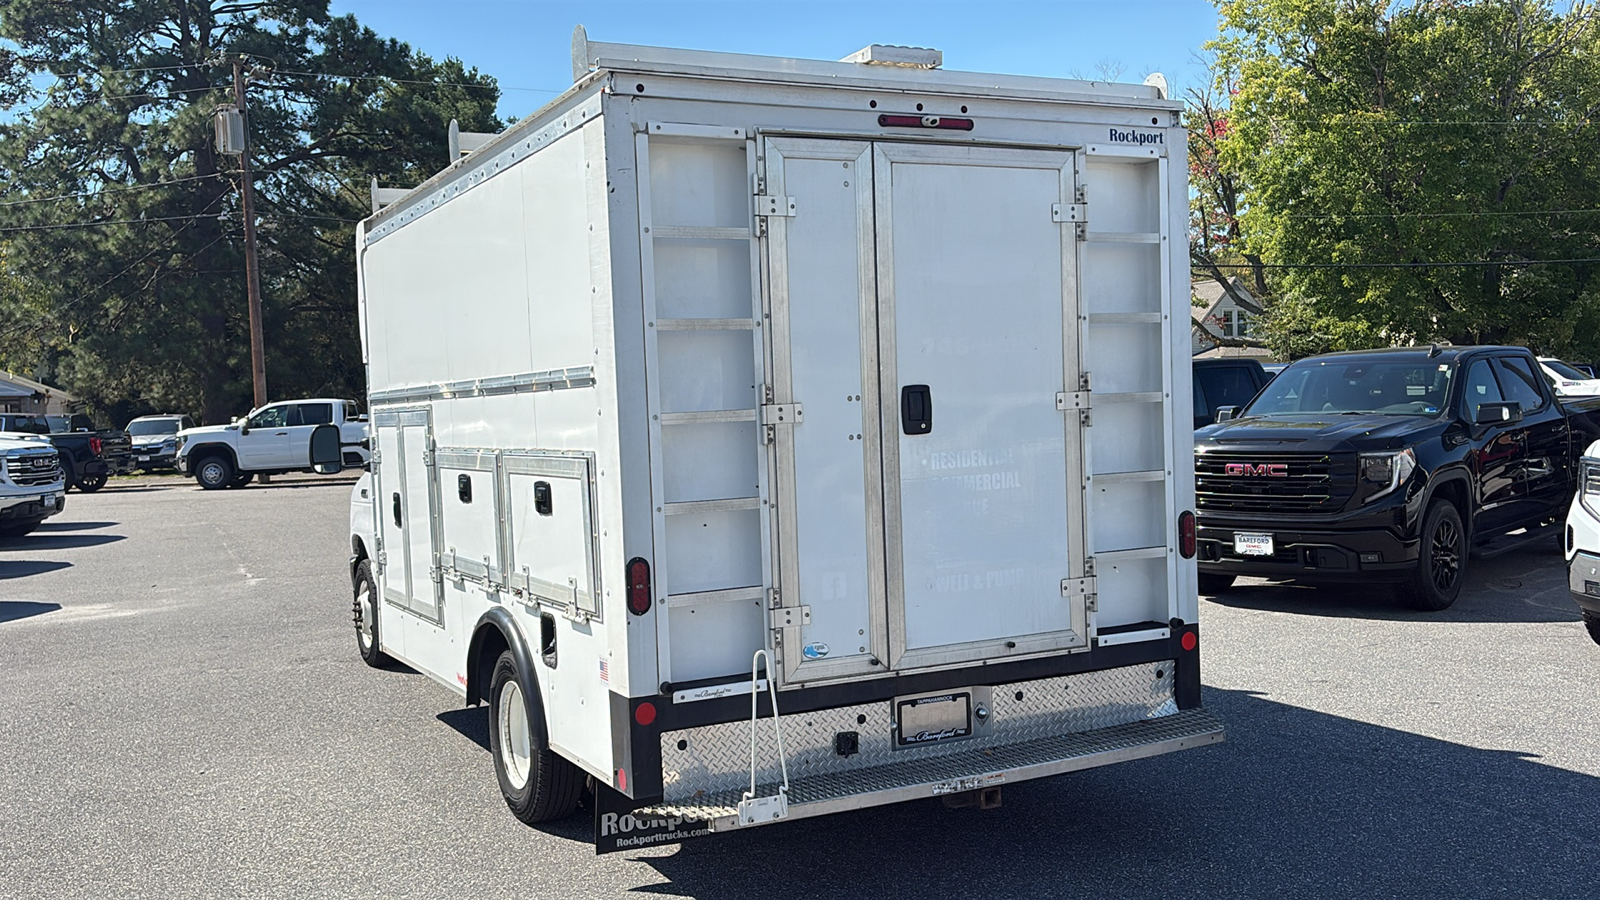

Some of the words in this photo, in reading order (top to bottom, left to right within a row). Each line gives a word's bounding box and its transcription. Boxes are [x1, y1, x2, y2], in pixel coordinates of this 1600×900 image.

[1109, 128, 1164, 146] Rockport
[1225, 463, 1288, 477] GMC
[917, 695, 953, 704] TAPPAHANNOCK
[916, 728, 957, 742] Bareford
[616, 828, 711, 848] Rockporttrucks.com
